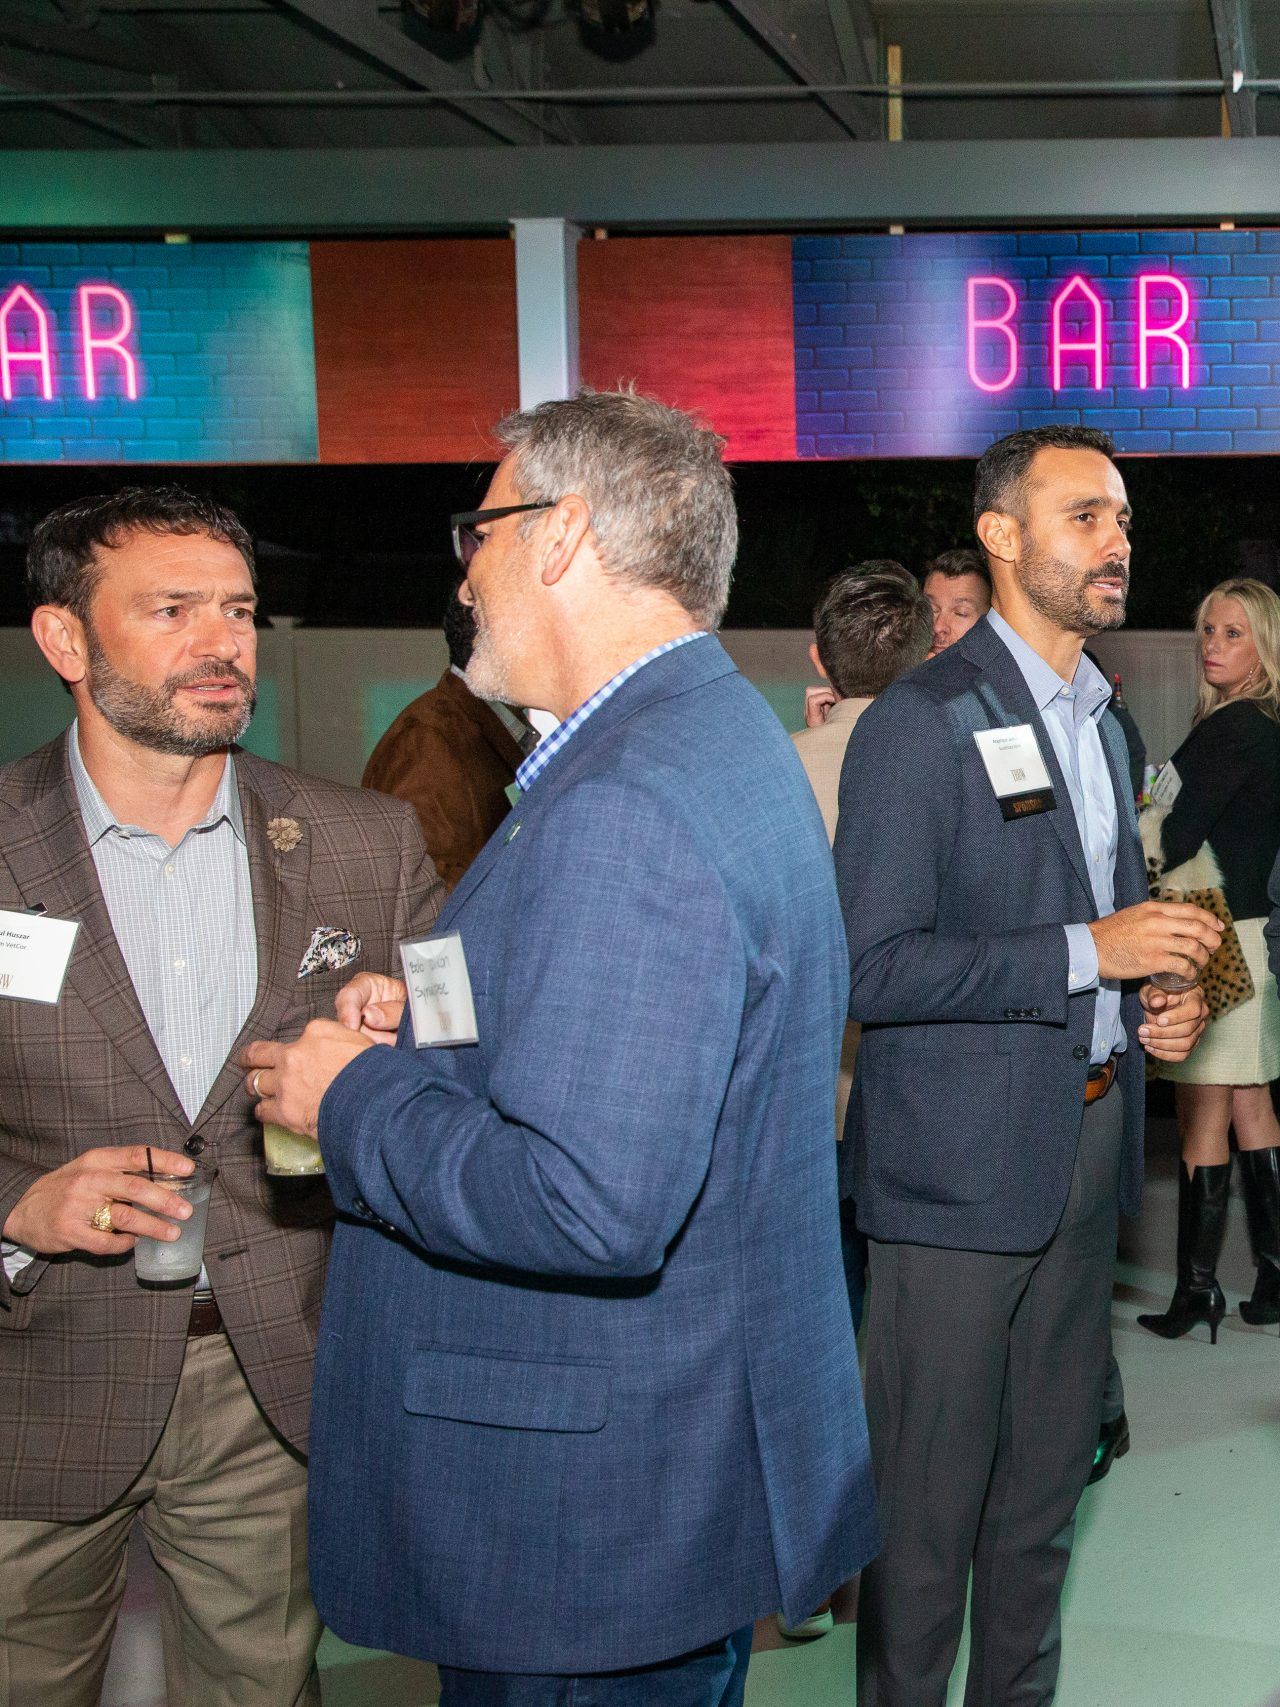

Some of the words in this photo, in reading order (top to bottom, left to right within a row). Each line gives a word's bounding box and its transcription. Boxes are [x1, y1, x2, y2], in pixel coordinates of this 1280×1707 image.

[966, 272, 1191, 392] BAR
[6, 931, 30, 940] Huszar
[6, 941, 27, 950] VetCor
